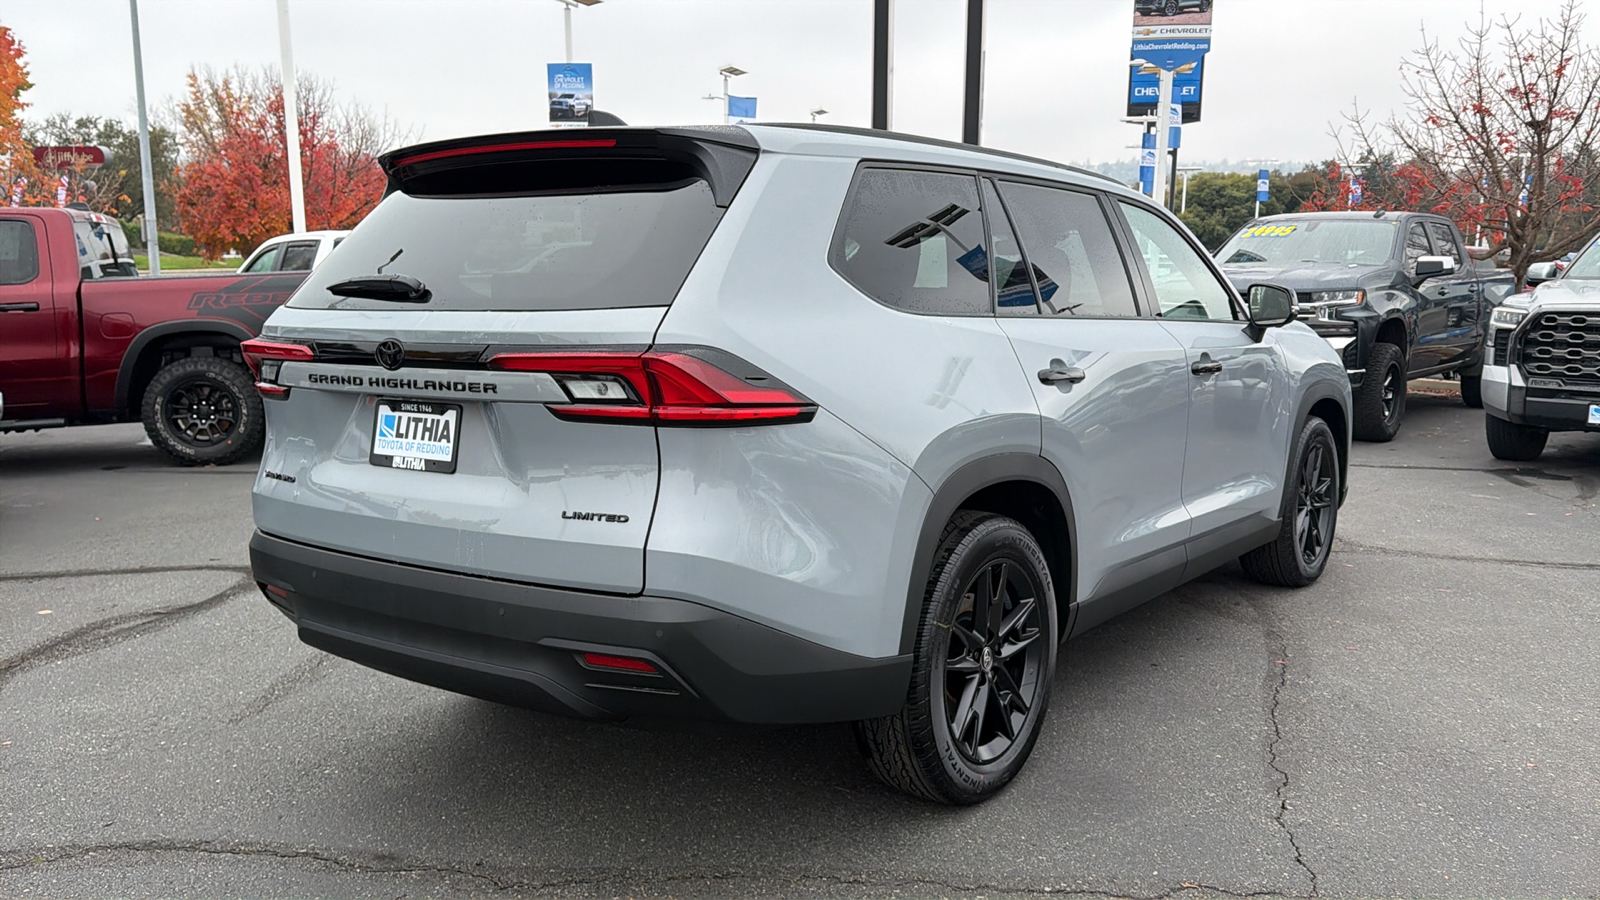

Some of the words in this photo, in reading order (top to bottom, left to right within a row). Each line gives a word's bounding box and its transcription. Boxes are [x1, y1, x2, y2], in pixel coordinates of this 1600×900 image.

[187, 291, 293, 310] REBE
[308, 373, 363, 386] GRAND
[368, 377, 498, 394] HIGHLANDER
[401, 403, 418, 412] SINCE
[419, 404, 433, 413] 1946
[395, 415, 451, 444] LITHIA
[378, 438, 404, 451] TOYOTA
[405, 442, 415, 452] OF
[416, 443, 451, 456] REDDING
[399, 456, 426, 471] LITHIA
[561, 510, 630, 523] LIMITED
